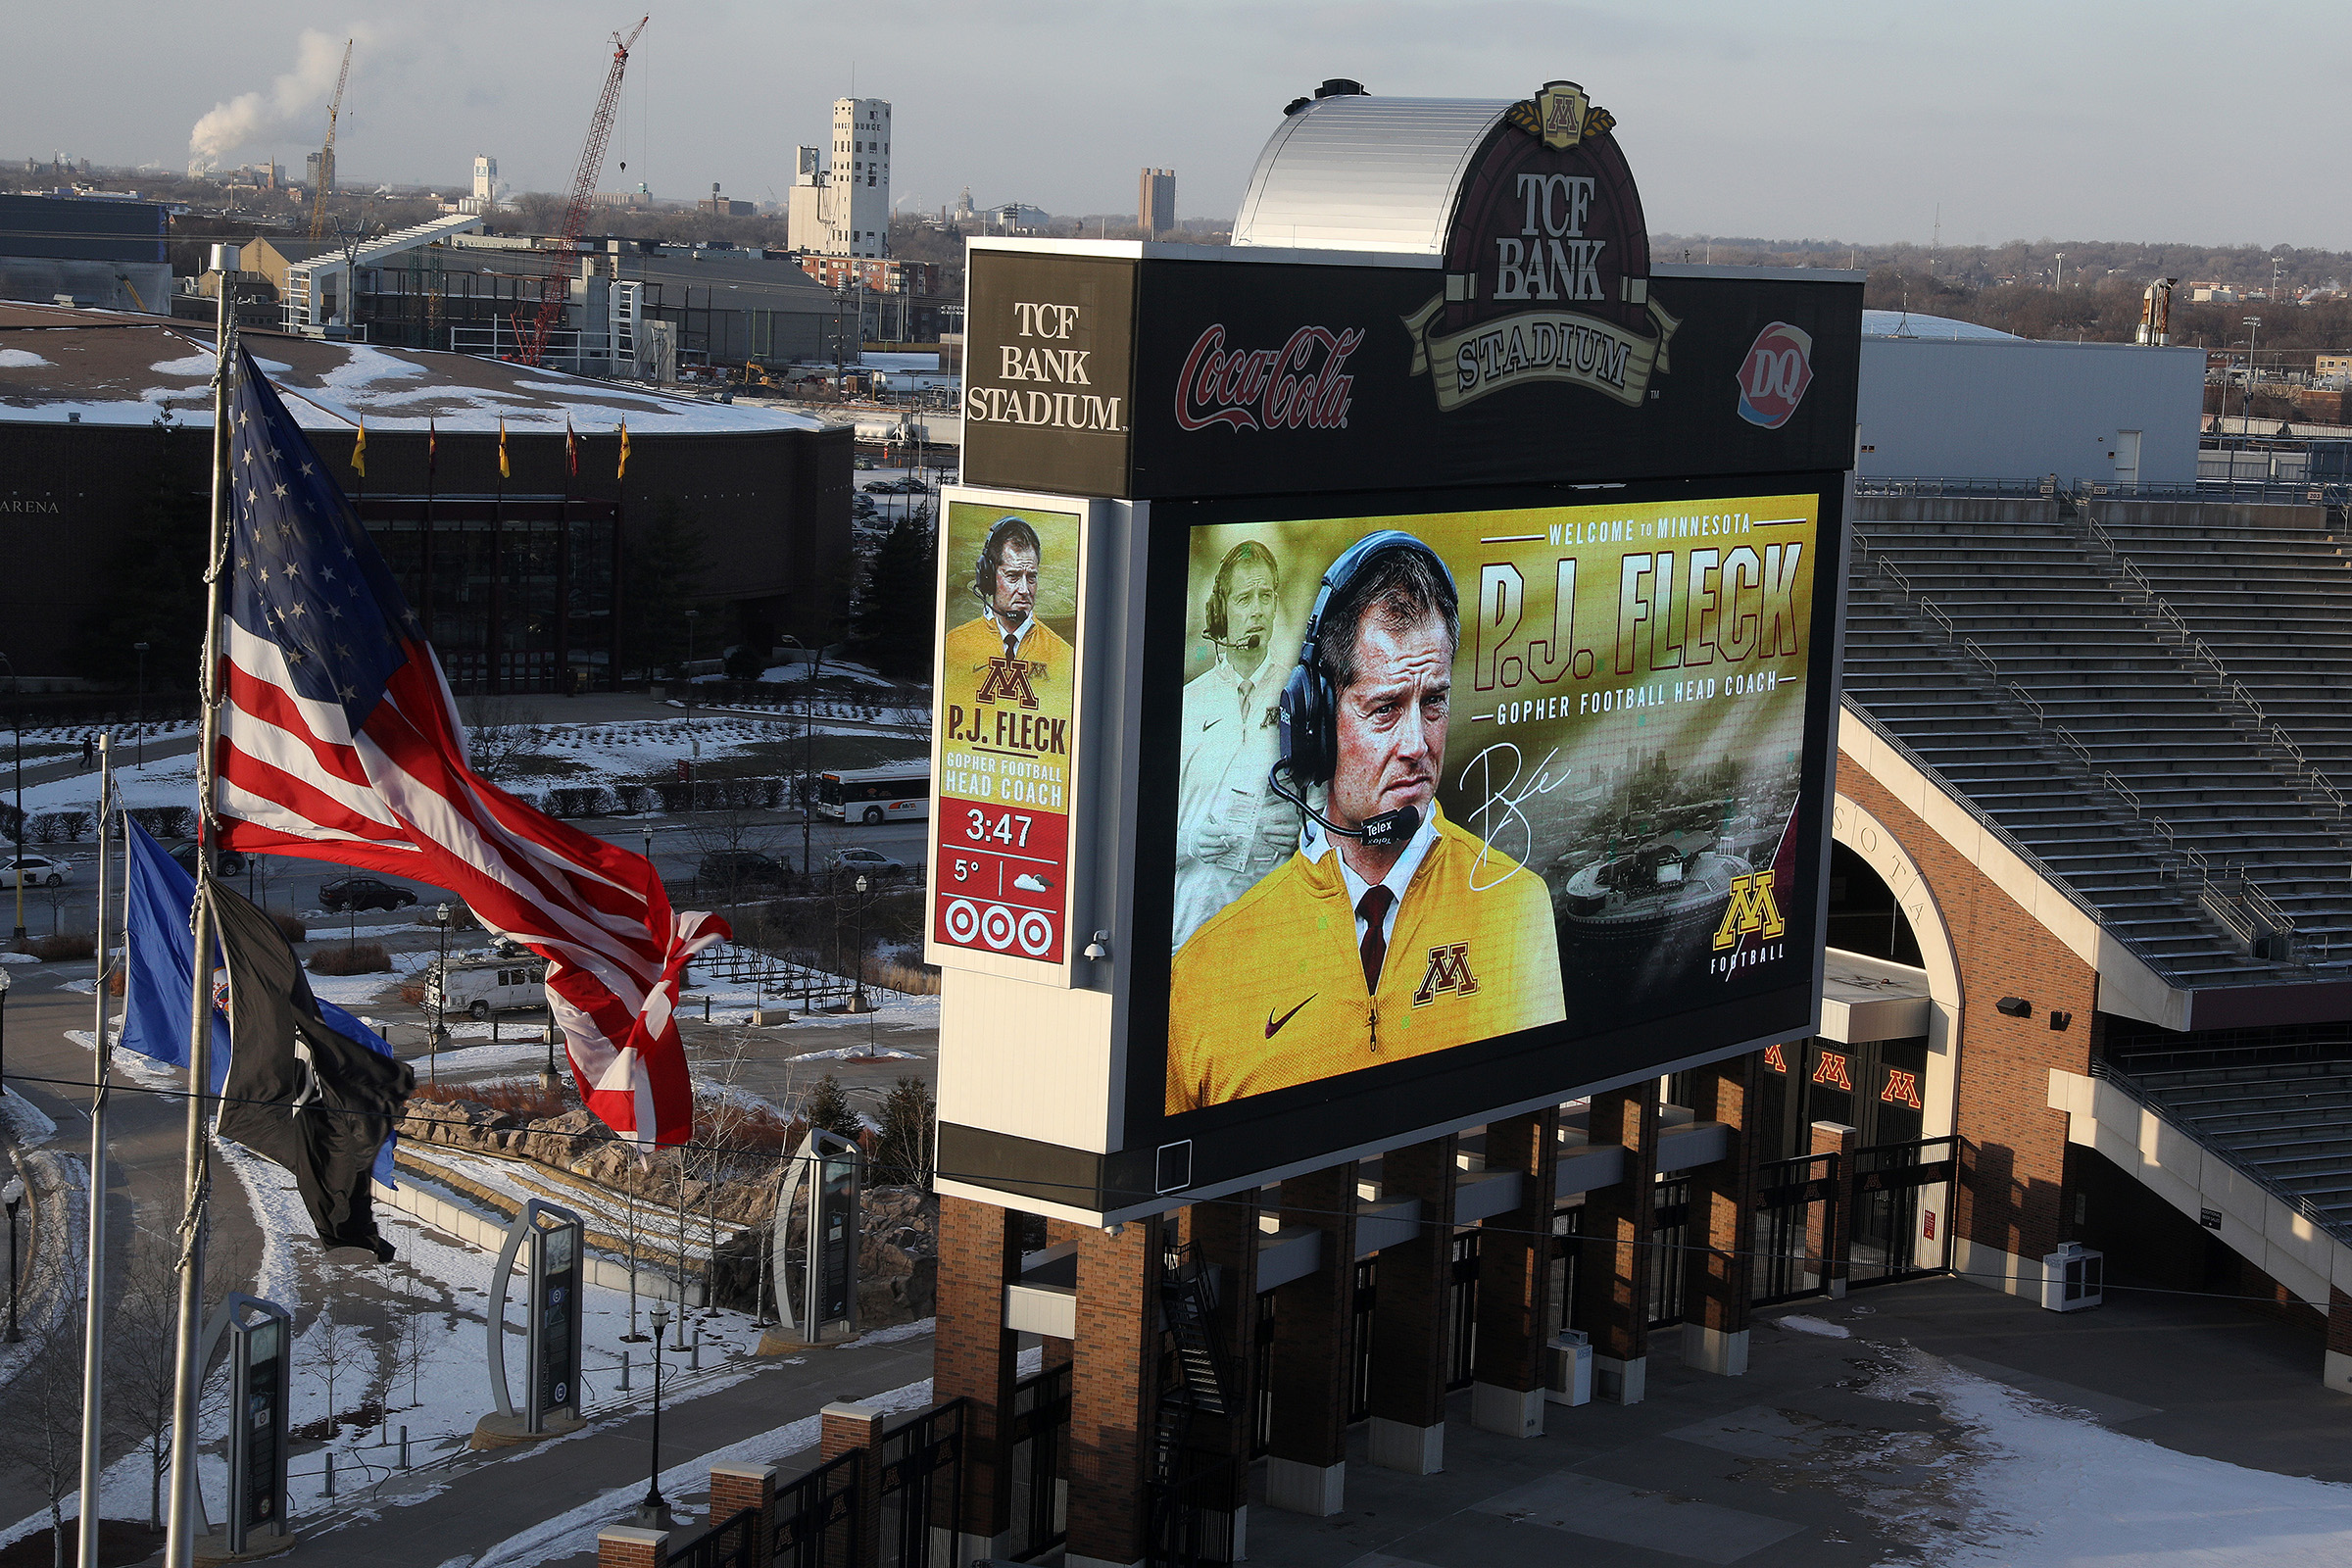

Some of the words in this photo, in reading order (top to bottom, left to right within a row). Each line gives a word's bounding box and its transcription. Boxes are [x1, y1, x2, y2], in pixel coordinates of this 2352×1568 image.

[855, 122, 881, 131] BUNGE
[1517, 173, 1594, 237] TCF
[1494, 237, 1606, 300] BANK
[1014, 302, 1079, 339] TCF
[999, 345, 1092, 385] BANK
[1456, 321, 1632, 392] STADIUM
[1749, 349, 1801, 405] DQ
[1175, 323, 1365, 433] Coca-Cola
[966, 386, 1122, 431] STADIUM
[0, 501, 59, 513] ARENA
[1549, 519, 1634, 546] WELCOME
[1657, 513, 1750, 539] MINNESOTA
[1474, 558, 1594, 692] P.J.
[1615, 541, 1803, 676] FLECK
[1497, 696, 1569, 726] GOPHER
[1580, 685, 1665, 715] FOOTBALL
[1674, 679, 1716, 704] HEAD
[1725, 670, 1776, 697] COACH
[949, 705, 989, 745] P.J.
[996, 710, 1067, 755] FLECK
[945, 769, 992, 798] HEAD
[1001, 777, 1061, 808] COACH
[947, 752, 997, 773] GOPHER
[1001, 760, 1062, 783] FOOTBALL
[965, 808, 1033, 848] 3:47
[1367, 821, 1392, 836] Telex
[1833, 806, 1924, 927] SOTA
[1710, 943, 1784, 974] FOOTBALL
